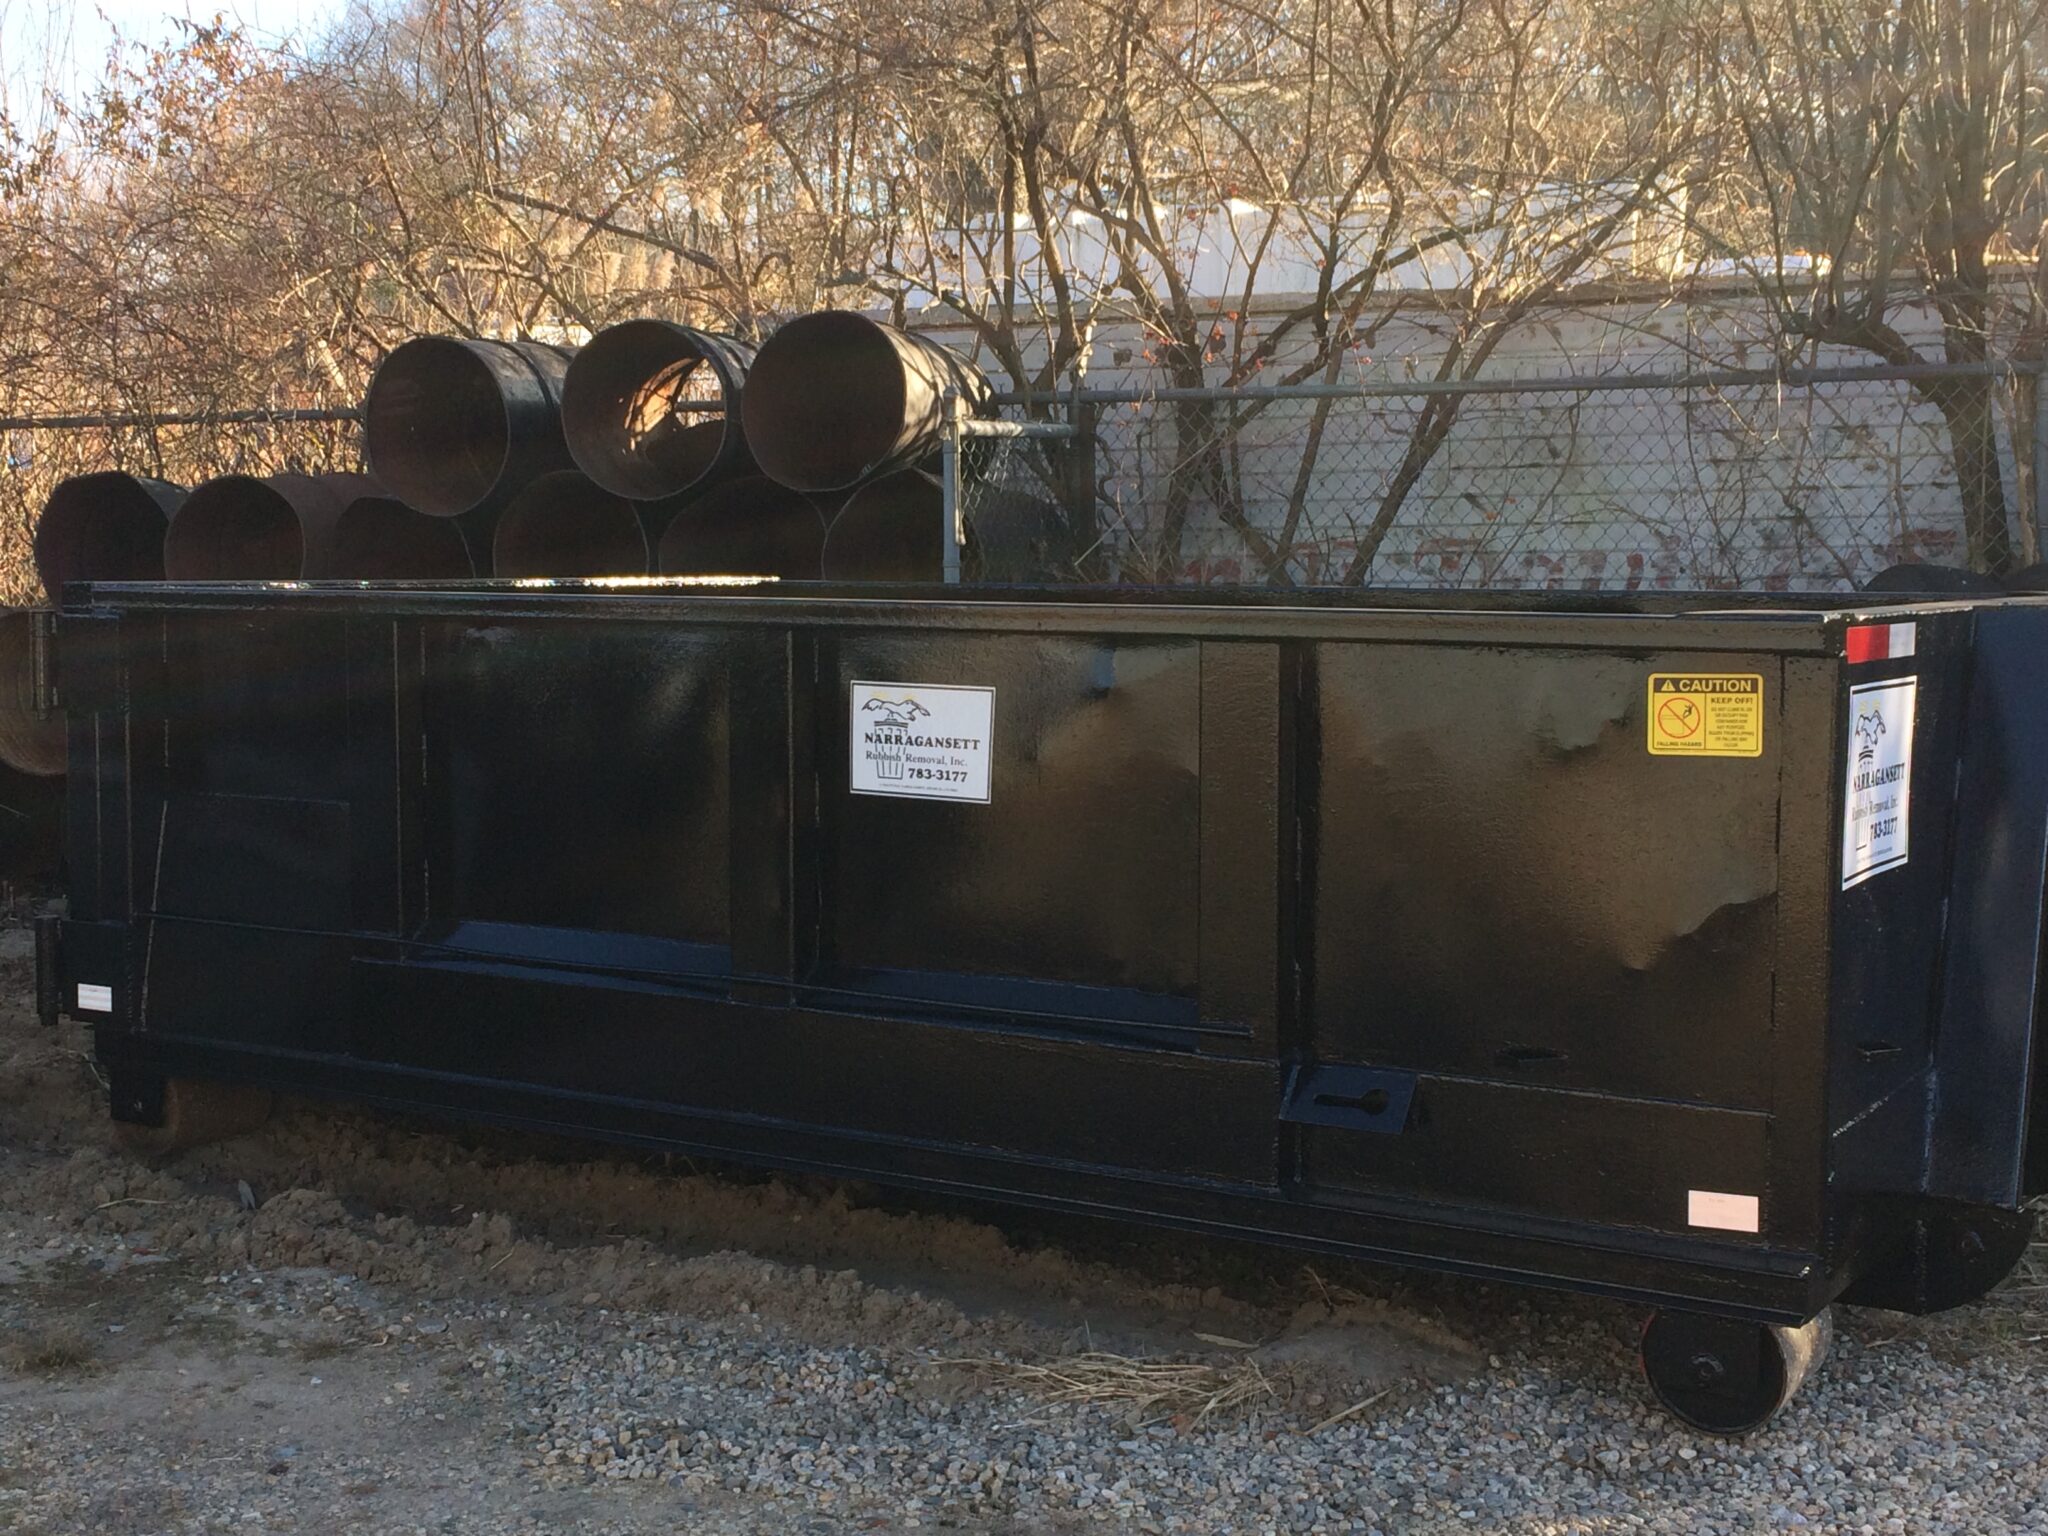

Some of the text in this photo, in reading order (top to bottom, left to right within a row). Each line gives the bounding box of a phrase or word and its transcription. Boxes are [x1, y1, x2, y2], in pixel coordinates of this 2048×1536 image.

[1679, 679, 1751, 692] CAUTION
[864, 732, 981, 750] NARRAGANSETT
[866, 750, 968, 767] Rubbish Removal, Inc.
[908, 768, 968, 783] 783-3177
[1853, 763, 1905, 793] NARRAGANSETT
[1870, 816, 1898, 842] 783-3177
